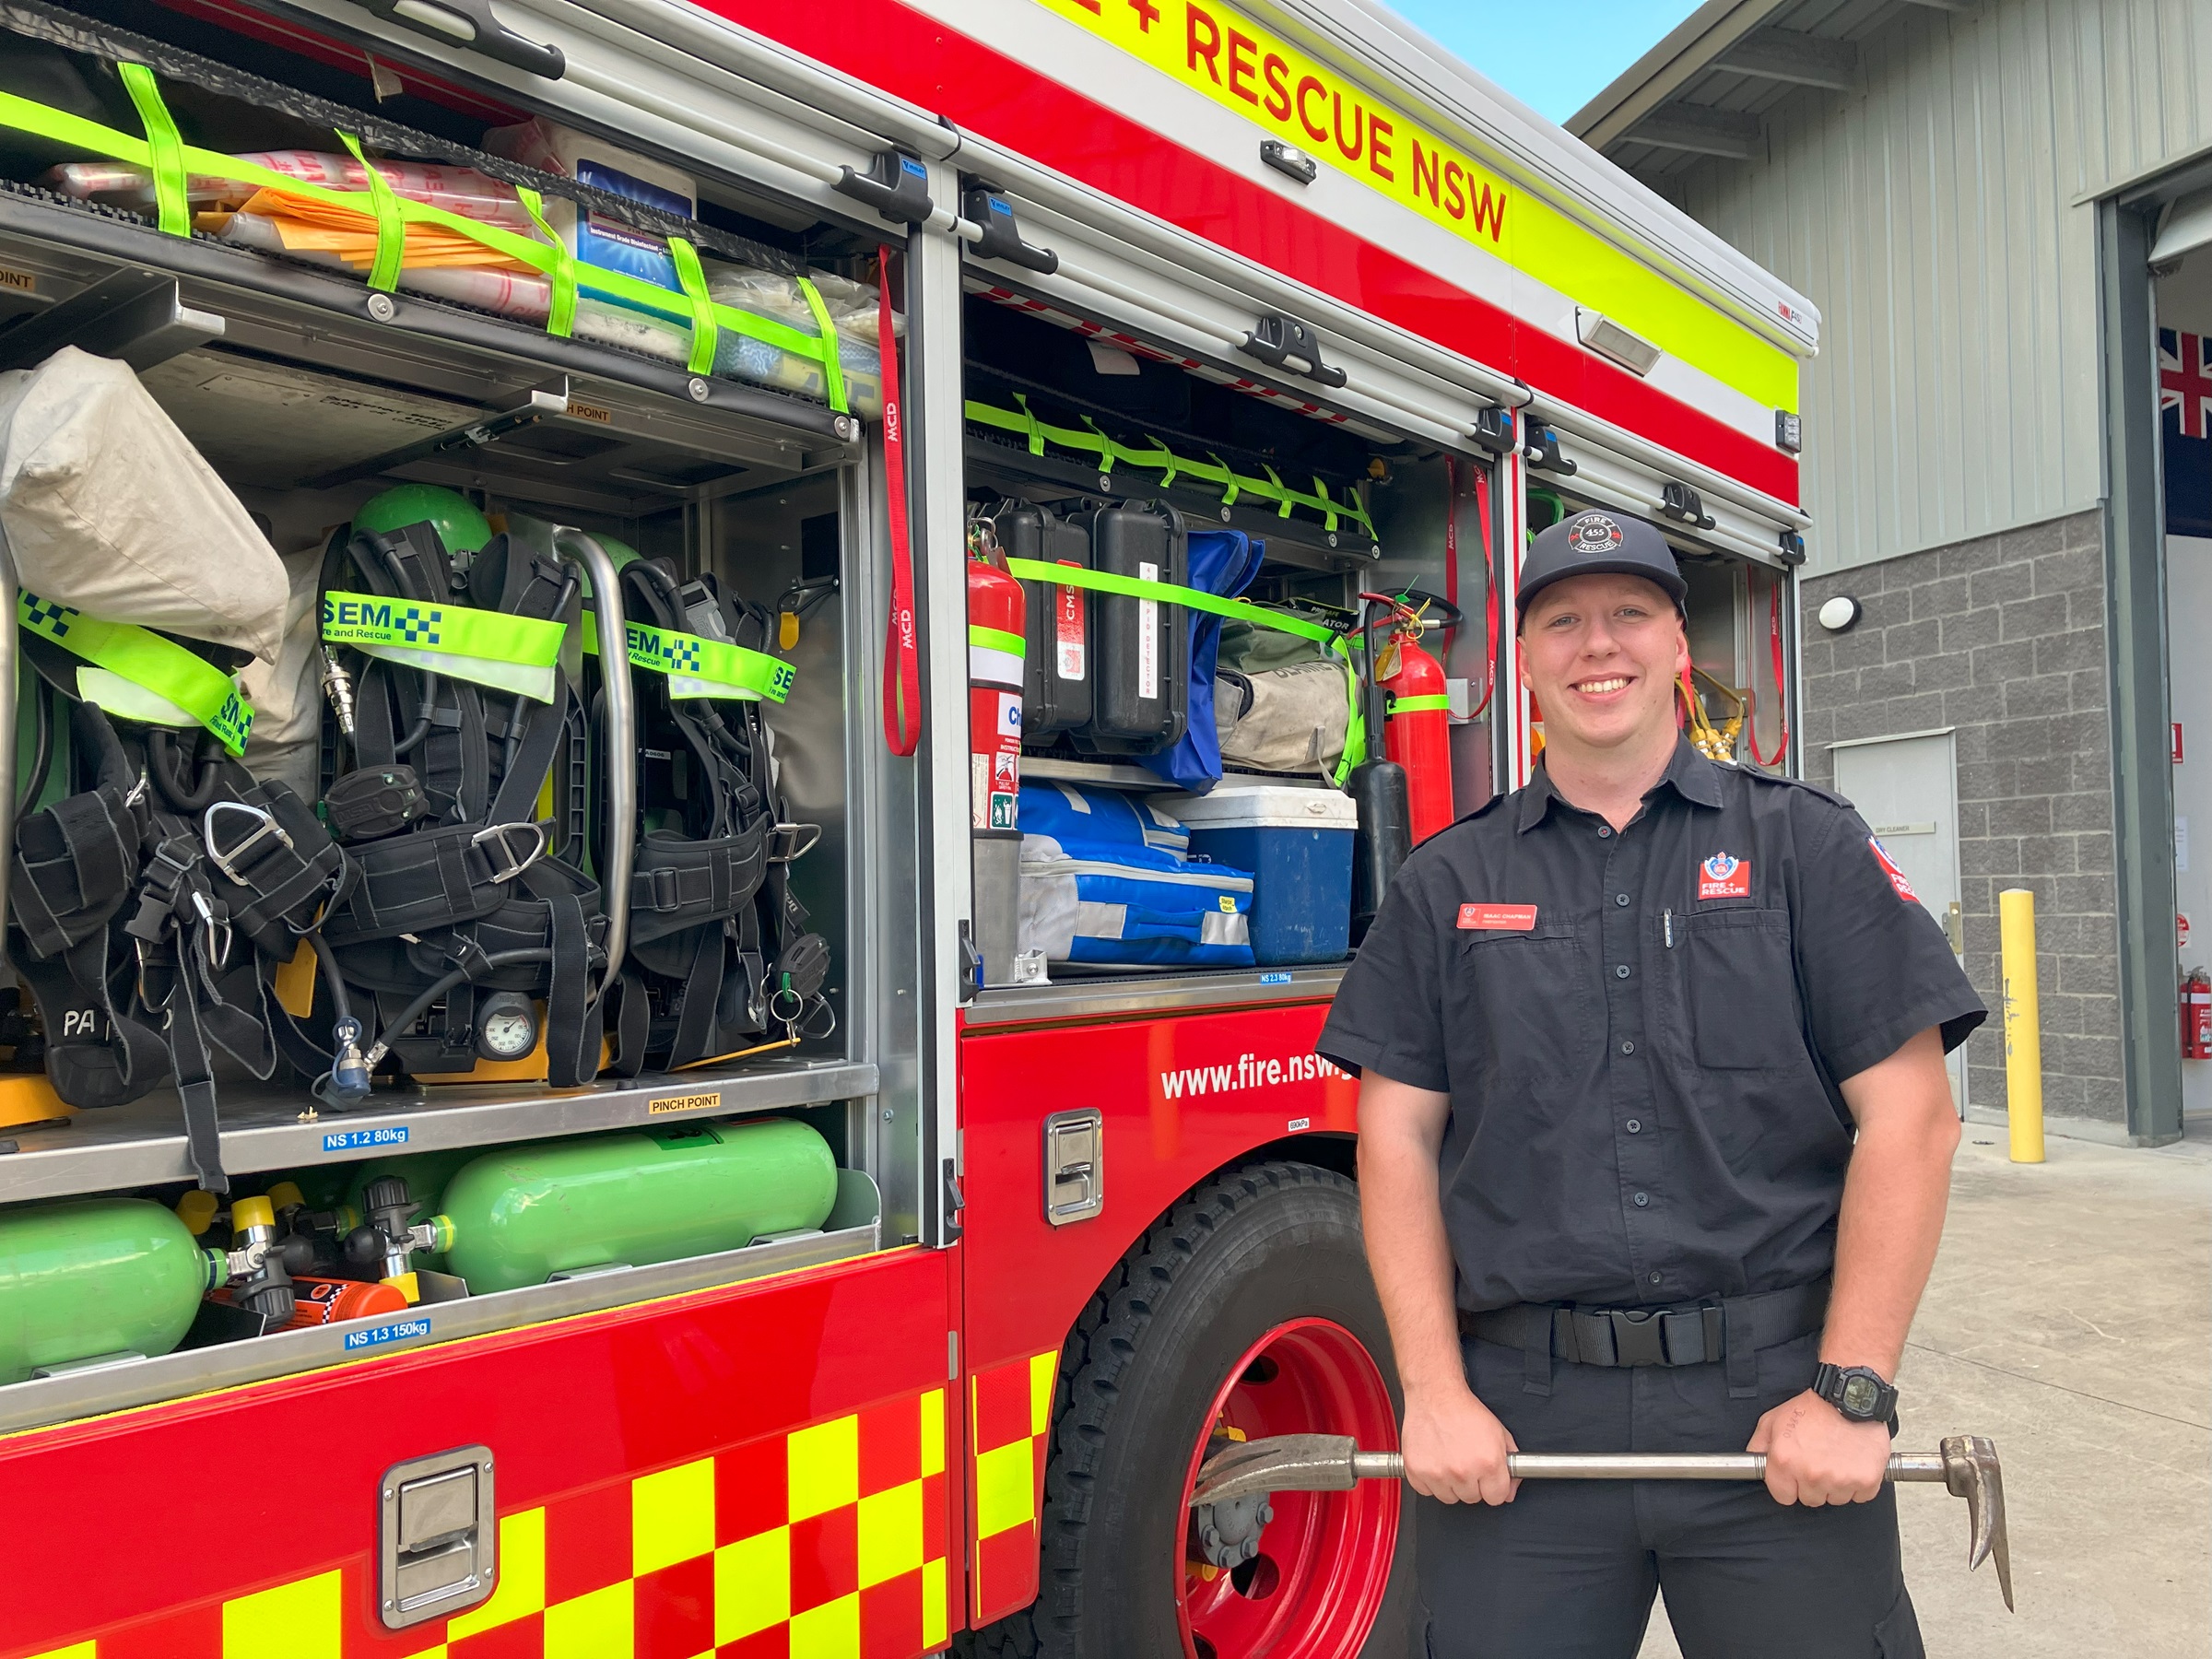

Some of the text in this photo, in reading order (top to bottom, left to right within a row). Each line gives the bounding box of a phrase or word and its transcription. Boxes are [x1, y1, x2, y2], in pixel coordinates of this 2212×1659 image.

[1185, 1, 1394, 183] RESCUE
[1411, 138, 1507, 243] NSW
[591, 227, 617, 240] Instrument
[617, 234, 629, 244] Grade
[630, 239, 658, 252] Disinfectant
[577, 406, 609, 421] POINT
[887, 402, 899, 442] MCD
[1584, 516, 1608, 524] FIRE
[1585, 528, 1605, 537] 455
[1579, 540, 1614, 551] RESCUE
[1065, 584, 1076, 620] CMS
[323, 599, 392, 628] SEM
[334, 629, 354, 638] and
[356, 629, 392, 641] Rescue
[900, 609, 913, 650] MCD
[626, 628, 660, 655] EM
[631, 652, 661, 666] Rescue
[1887, 825, 1910, 833] CLEANER
[1701, 882, 1726, 890] FIRE
[1701, 887, 1746, 896] RESCUE
[1261, 974, 1269, 982] NS
[1278, 972, 1290, 983] 80kg
[64, 1010, 95, 1037] PA
[653, 1095, 719, 1112] PINCH POINT
[327, 1128, 406, 1148] NS 1.2 80kg
[349, 1322, 428, 1347] NS 1.3 150kg
